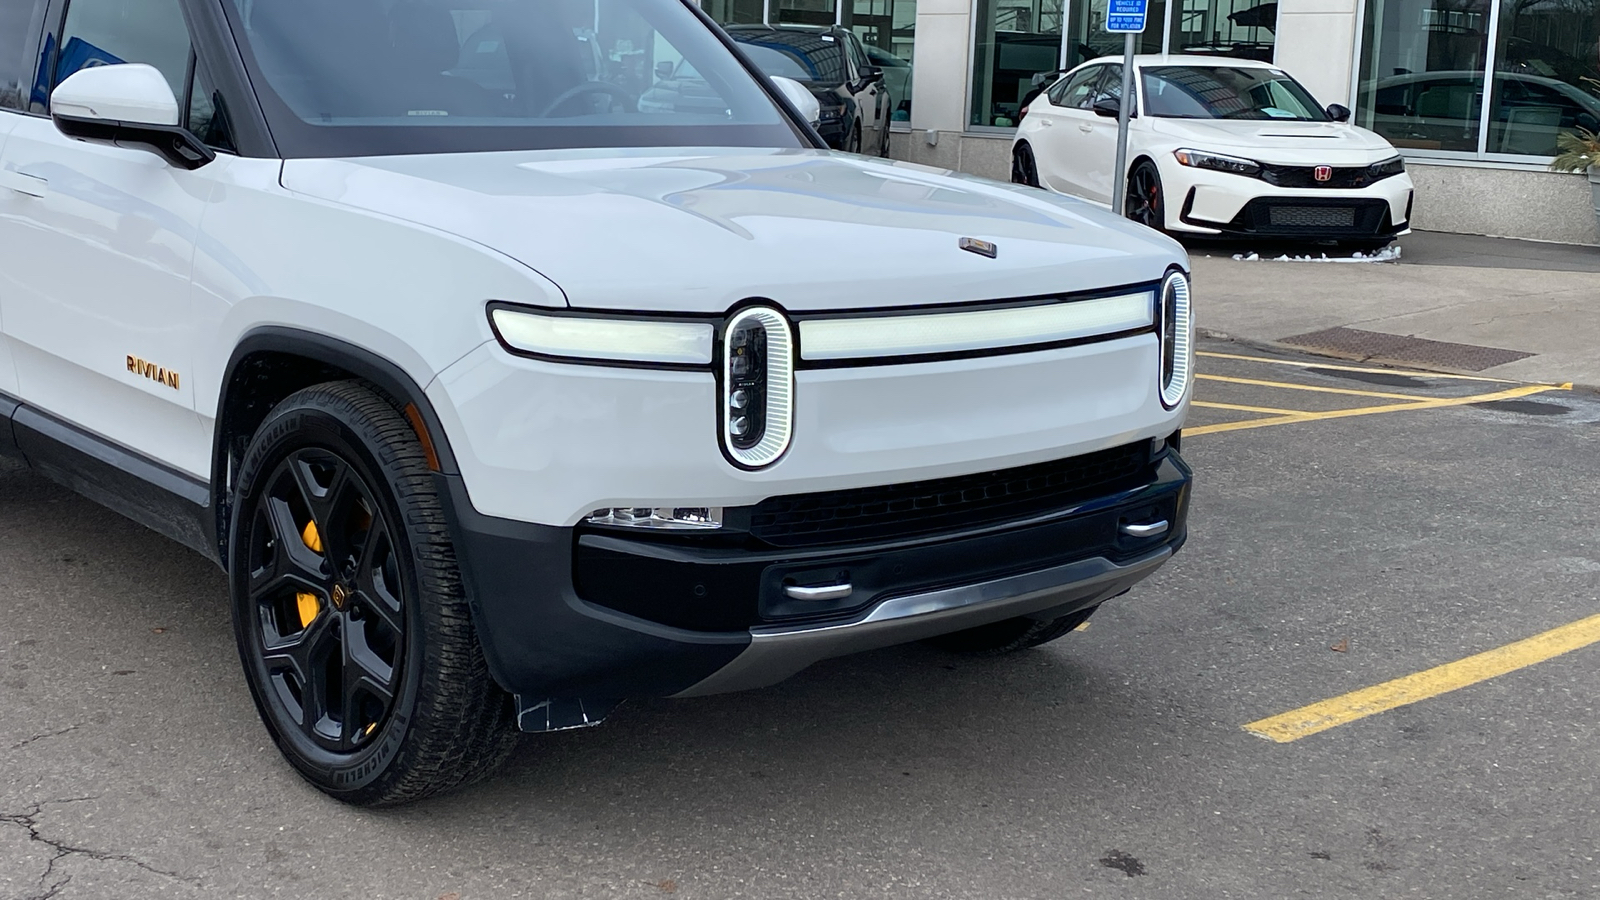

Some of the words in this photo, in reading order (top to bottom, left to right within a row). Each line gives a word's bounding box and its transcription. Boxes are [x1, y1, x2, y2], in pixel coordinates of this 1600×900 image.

[126, 354, 180, 390] RIVIAN
[250, 417, 298, 469] MICHELIN
[336, 741, 390, 783] MICHELIN
